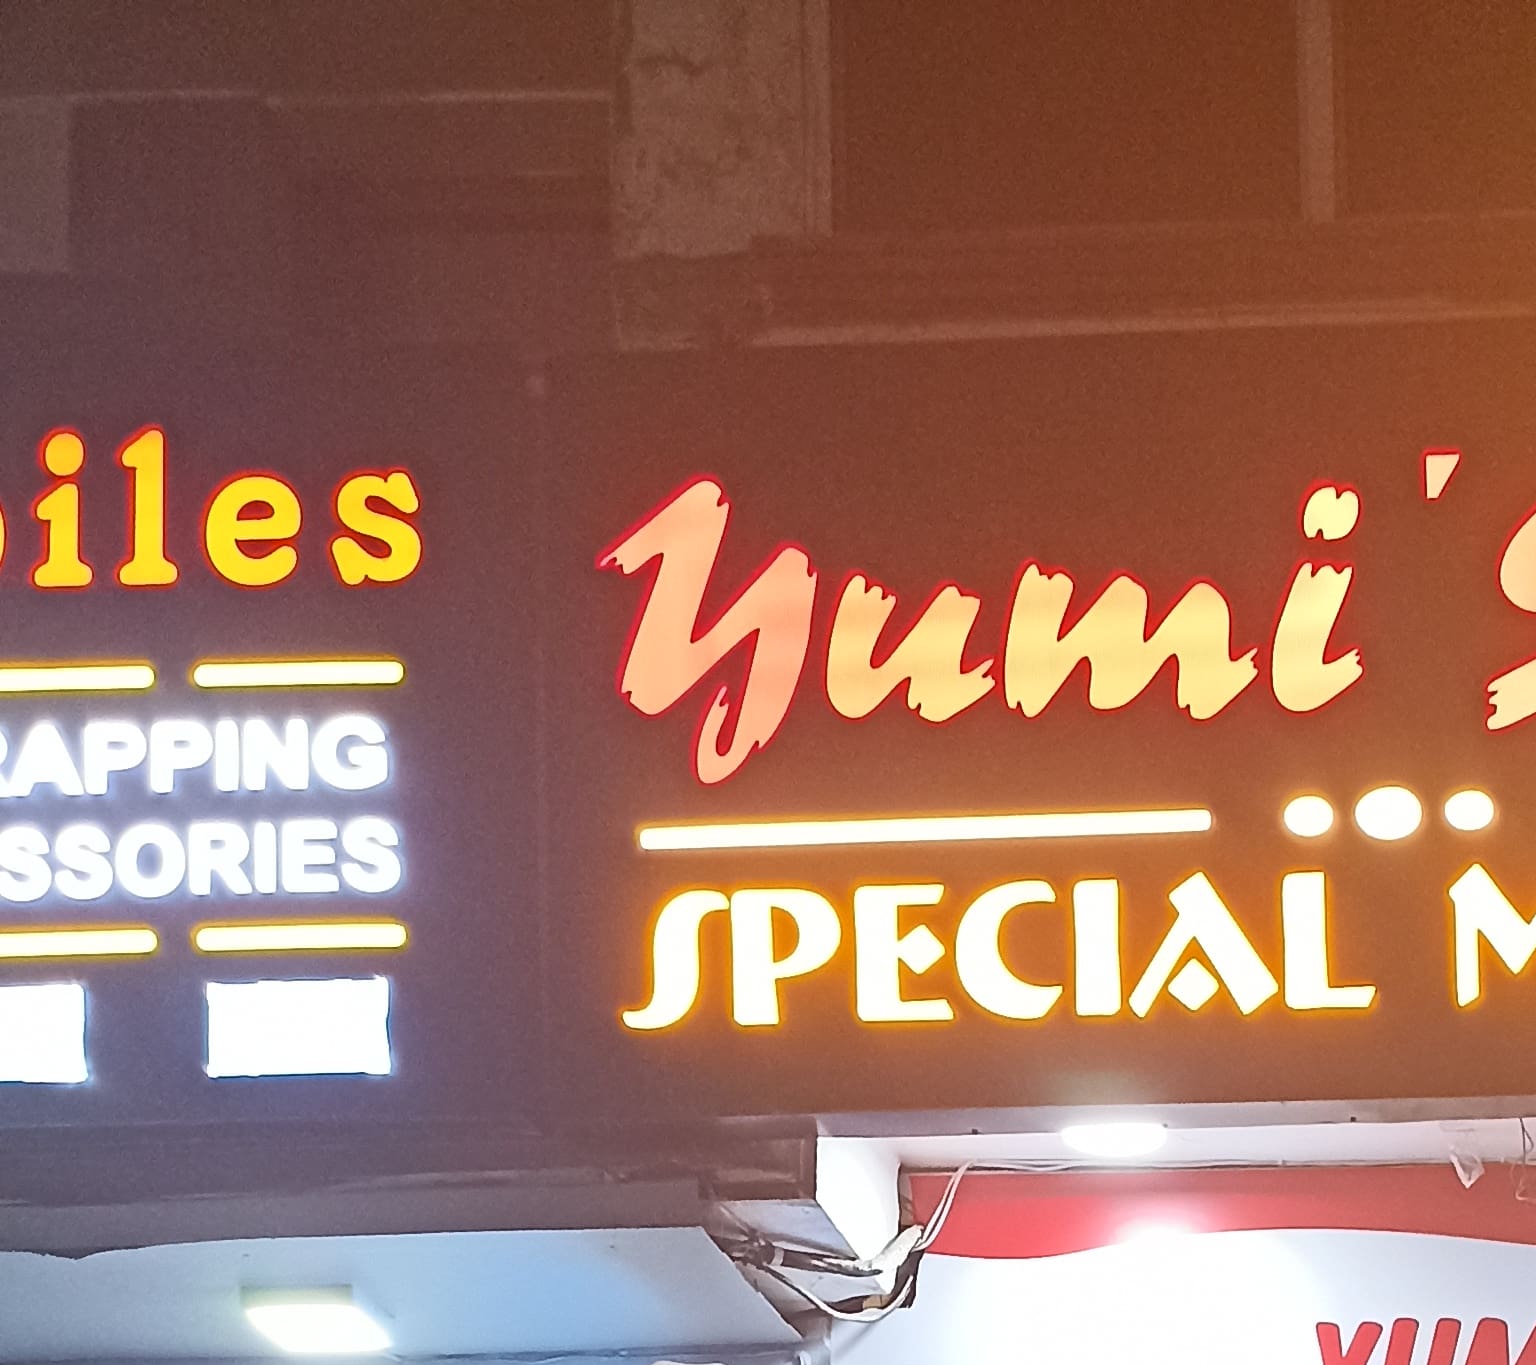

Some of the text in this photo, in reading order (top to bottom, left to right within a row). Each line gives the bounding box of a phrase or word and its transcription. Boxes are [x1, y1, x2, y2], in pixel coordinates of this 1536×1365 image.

[0, 425, 422, 588] iles
[0, 717, 389, 797] APPING
[622, 871, 1376, 1029] SPECIAL
